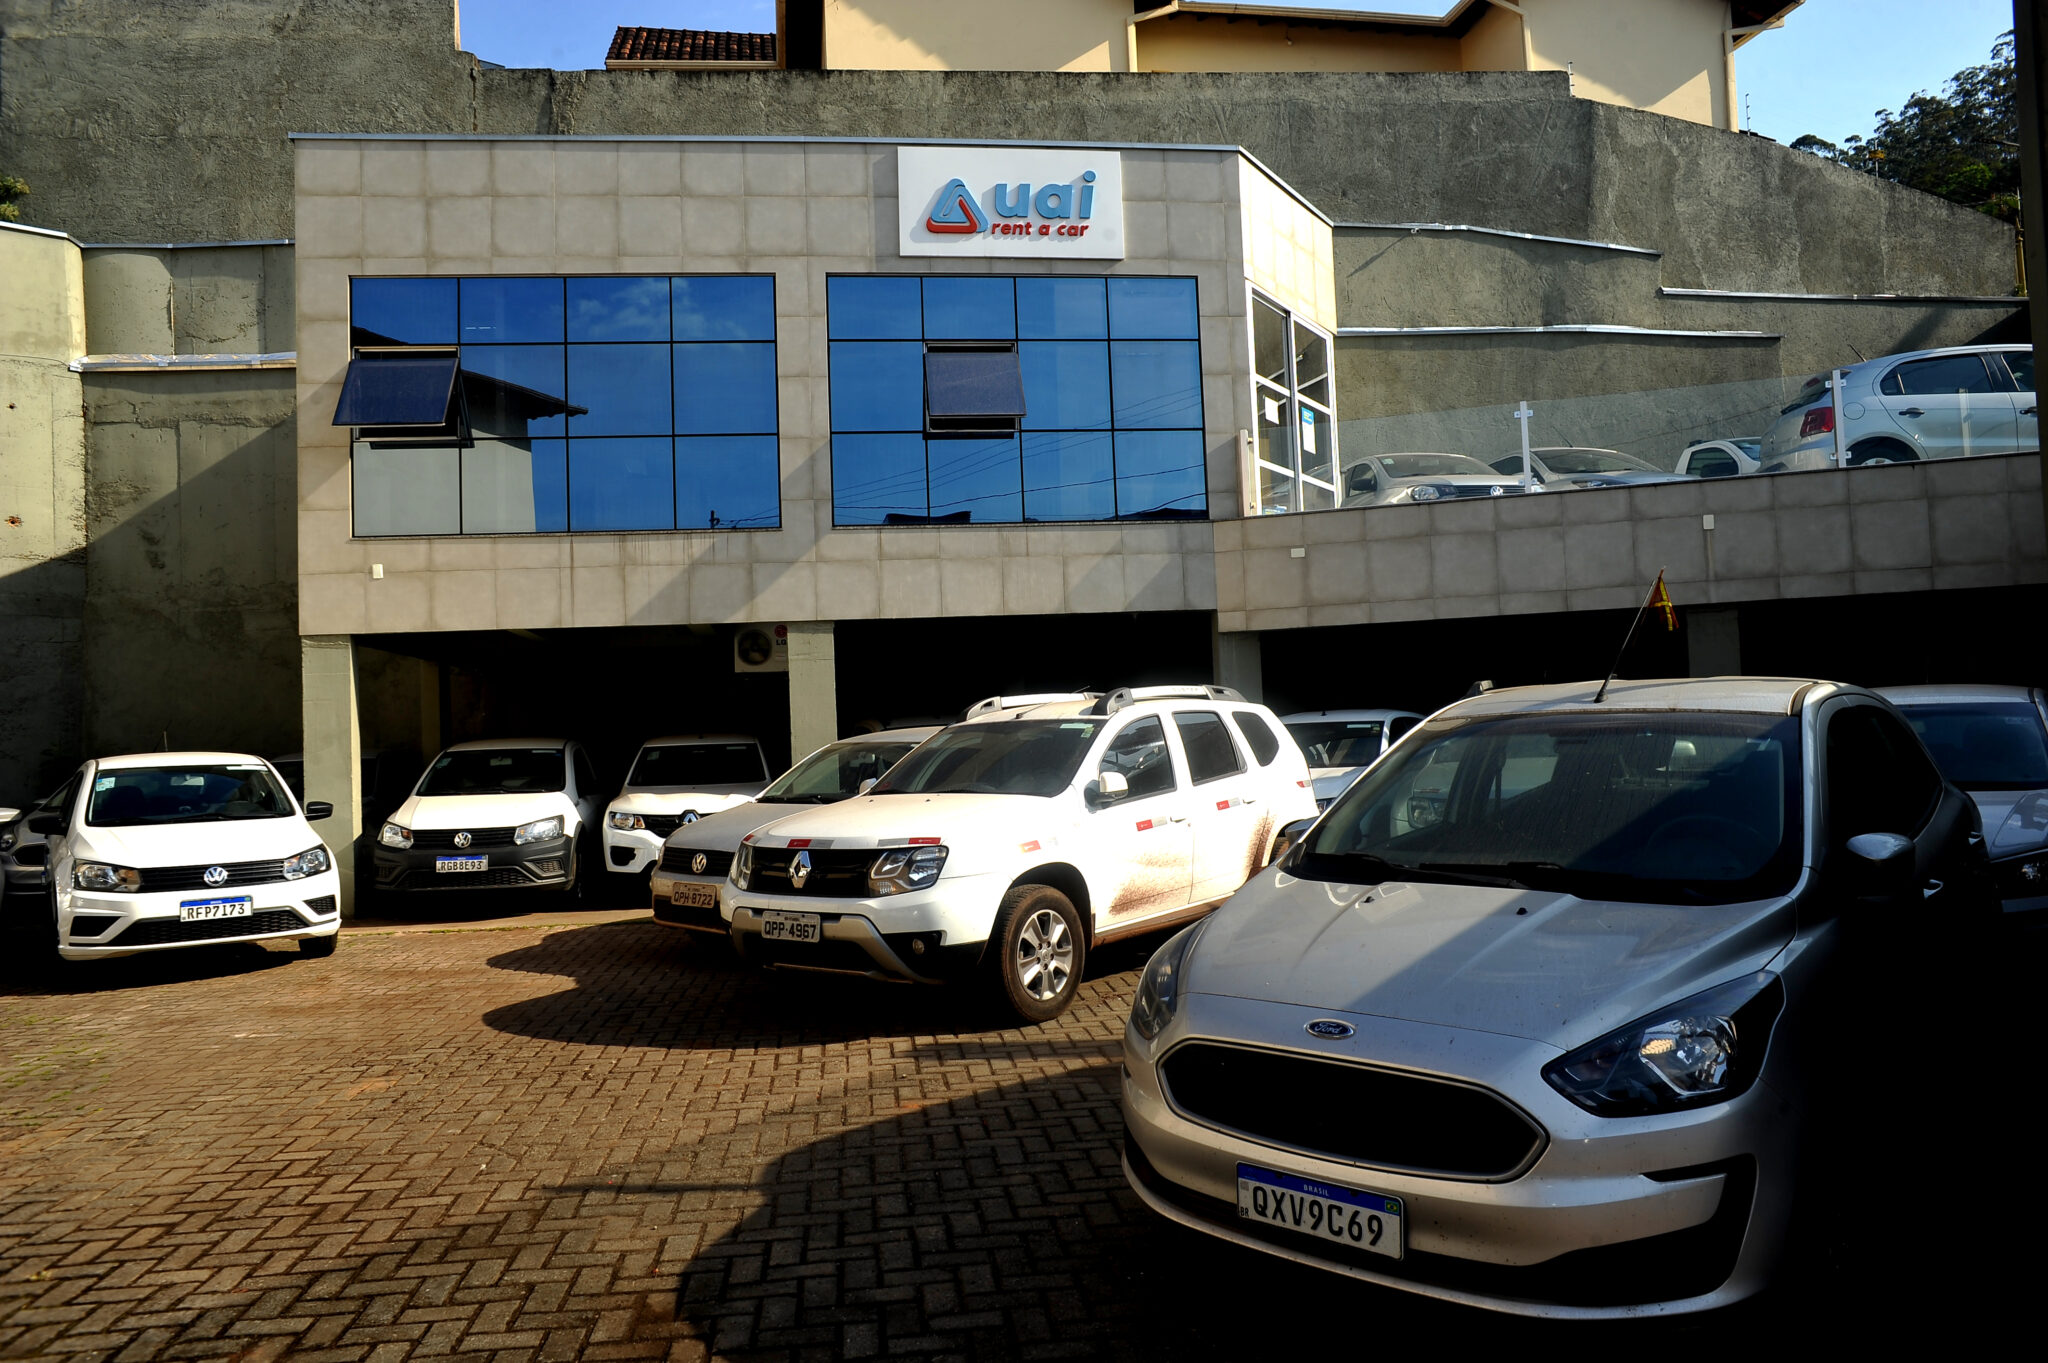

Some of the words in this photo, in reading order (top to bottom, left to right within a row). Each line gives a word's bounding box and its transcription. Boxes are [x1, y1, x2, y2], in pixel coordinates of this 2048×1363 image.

[994, 170, 1097, 219] uai
[991, 221, 1032, 236] rent
[1038, 224, 1051, 236] a
[1057, 224, 1089, 237] car
[1314, 1022, 1343, 1034] Ford
[1303, 1184, 1329, 1197] BRASIL
[1240, 1206, 1249, 1217] BR
[1253, 1186, 1383, 1247] QXV9C69
